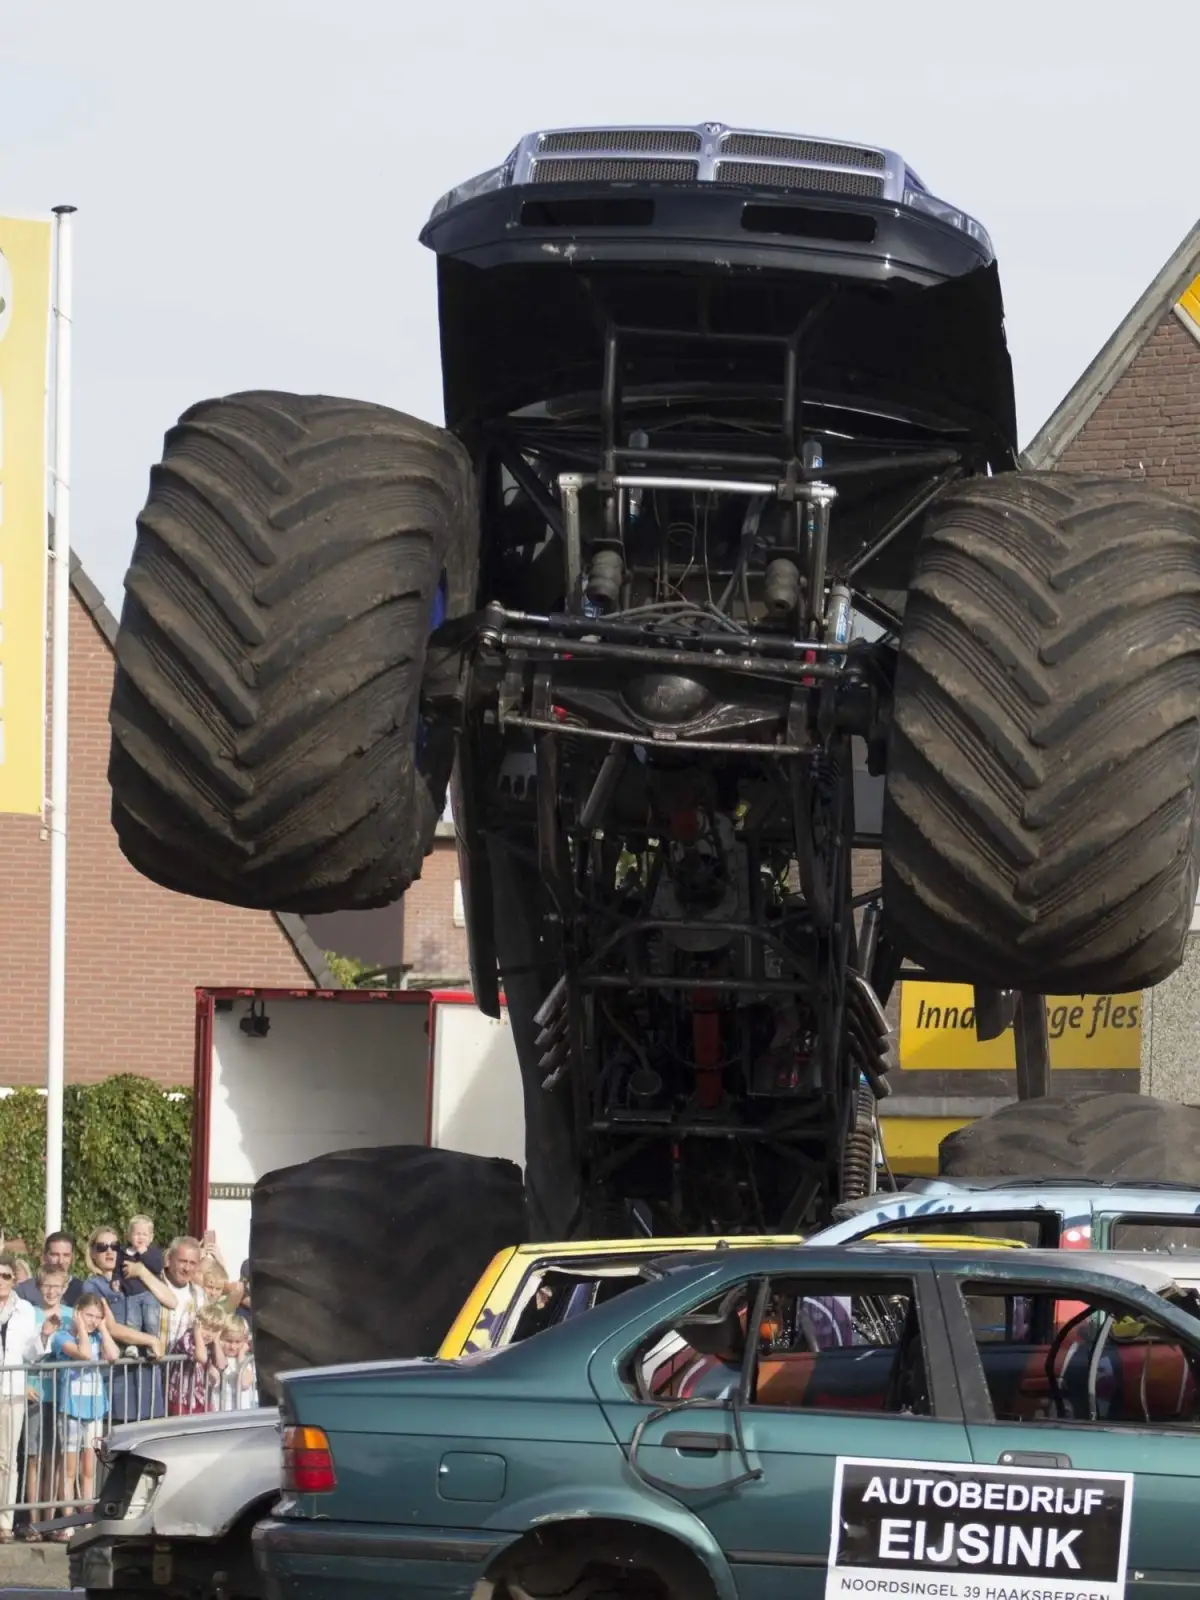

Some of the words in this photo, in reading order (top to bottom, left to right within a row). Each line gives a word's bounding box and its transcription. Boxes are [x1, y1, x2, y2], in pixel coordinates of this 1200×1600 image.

[917, 1000, 975, 1029] Inna
[1047, 1006, 1084, 1038] ge
[1085, 996, 1141, 1038] fles
[862, 1477, 1104, 1515] AUTOBEDRIJF
[878, 1519, 1083, 1569] EIJSINK
[841, 1578, 958, 1596] NOORDSINGEL
[963, 1586, 980, 1598] 39
